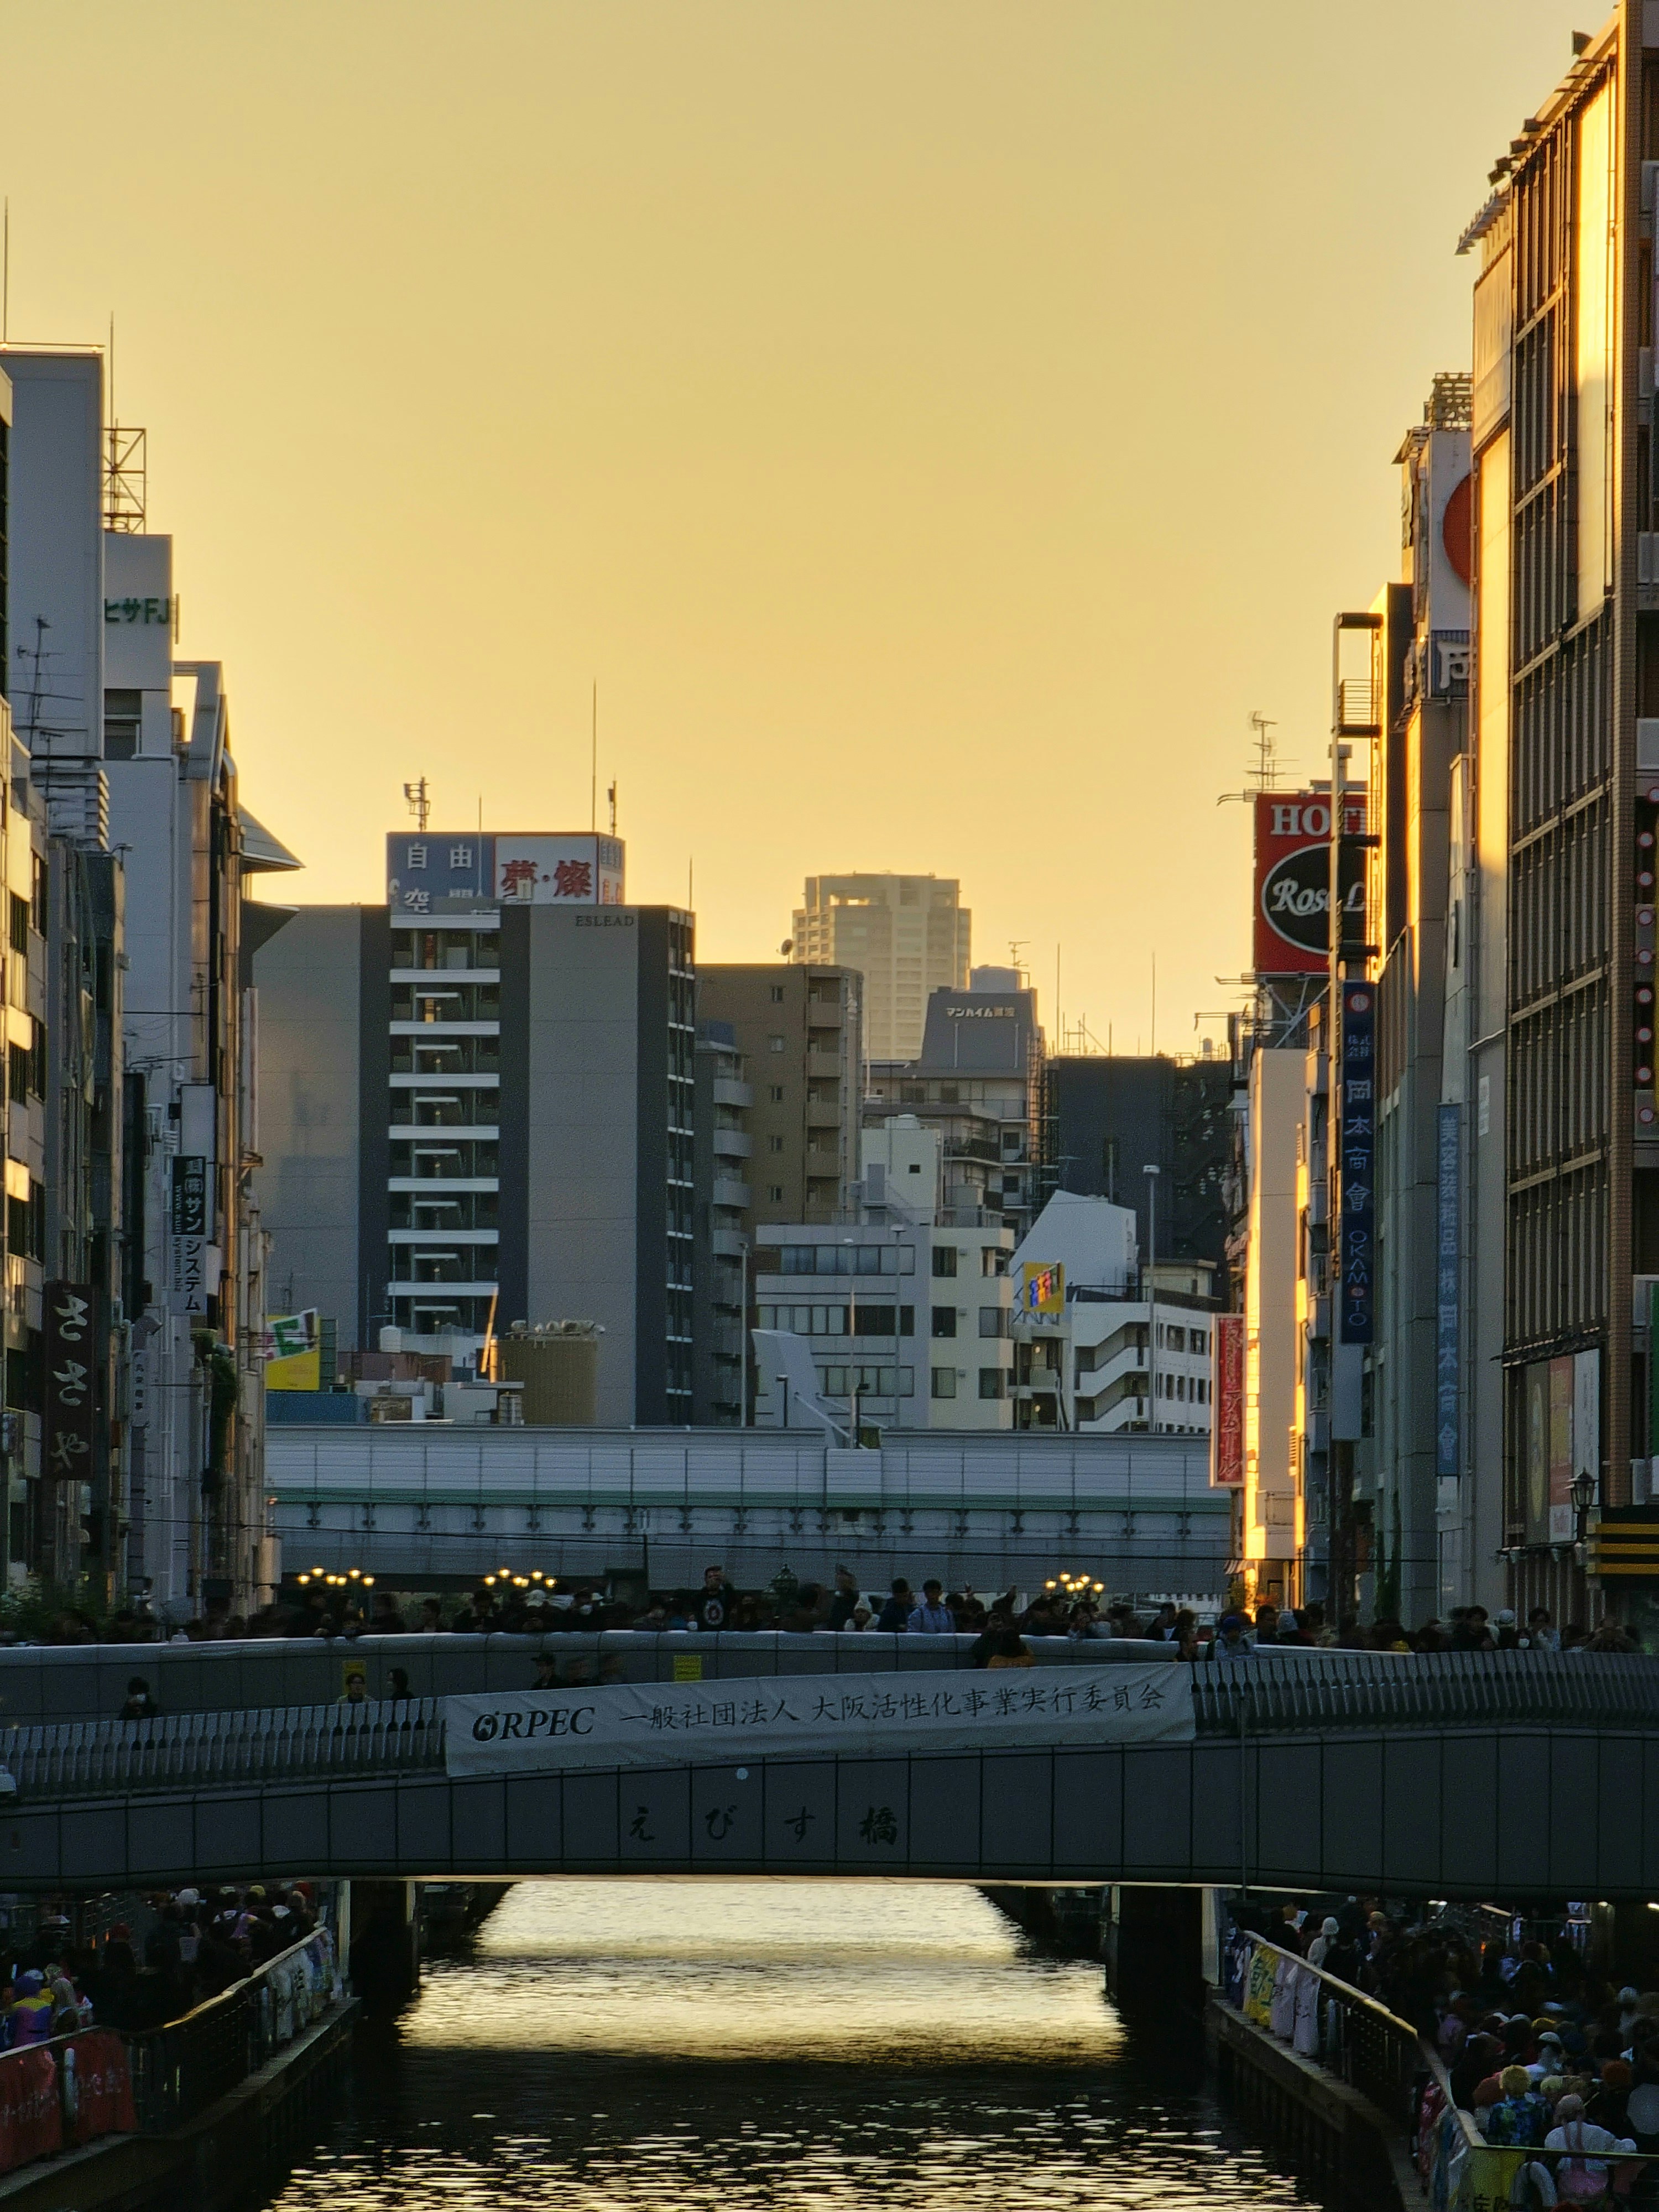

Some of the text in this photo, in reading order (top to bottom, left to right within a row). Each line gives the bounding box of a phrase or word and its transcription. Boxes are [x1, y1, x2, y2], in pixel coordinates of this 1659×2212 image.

[407, 842, 473, 870] 自由
[575, 915, 634, 926] ESLEAD
[1347, 1230, 1368, 1326] OKAMOTO
[472, 1683, 1167, 1742] ORPEC 一般社団法人 大阪活性化事業実行委員会
[629, 1804, 899, 1846] えびす橋
